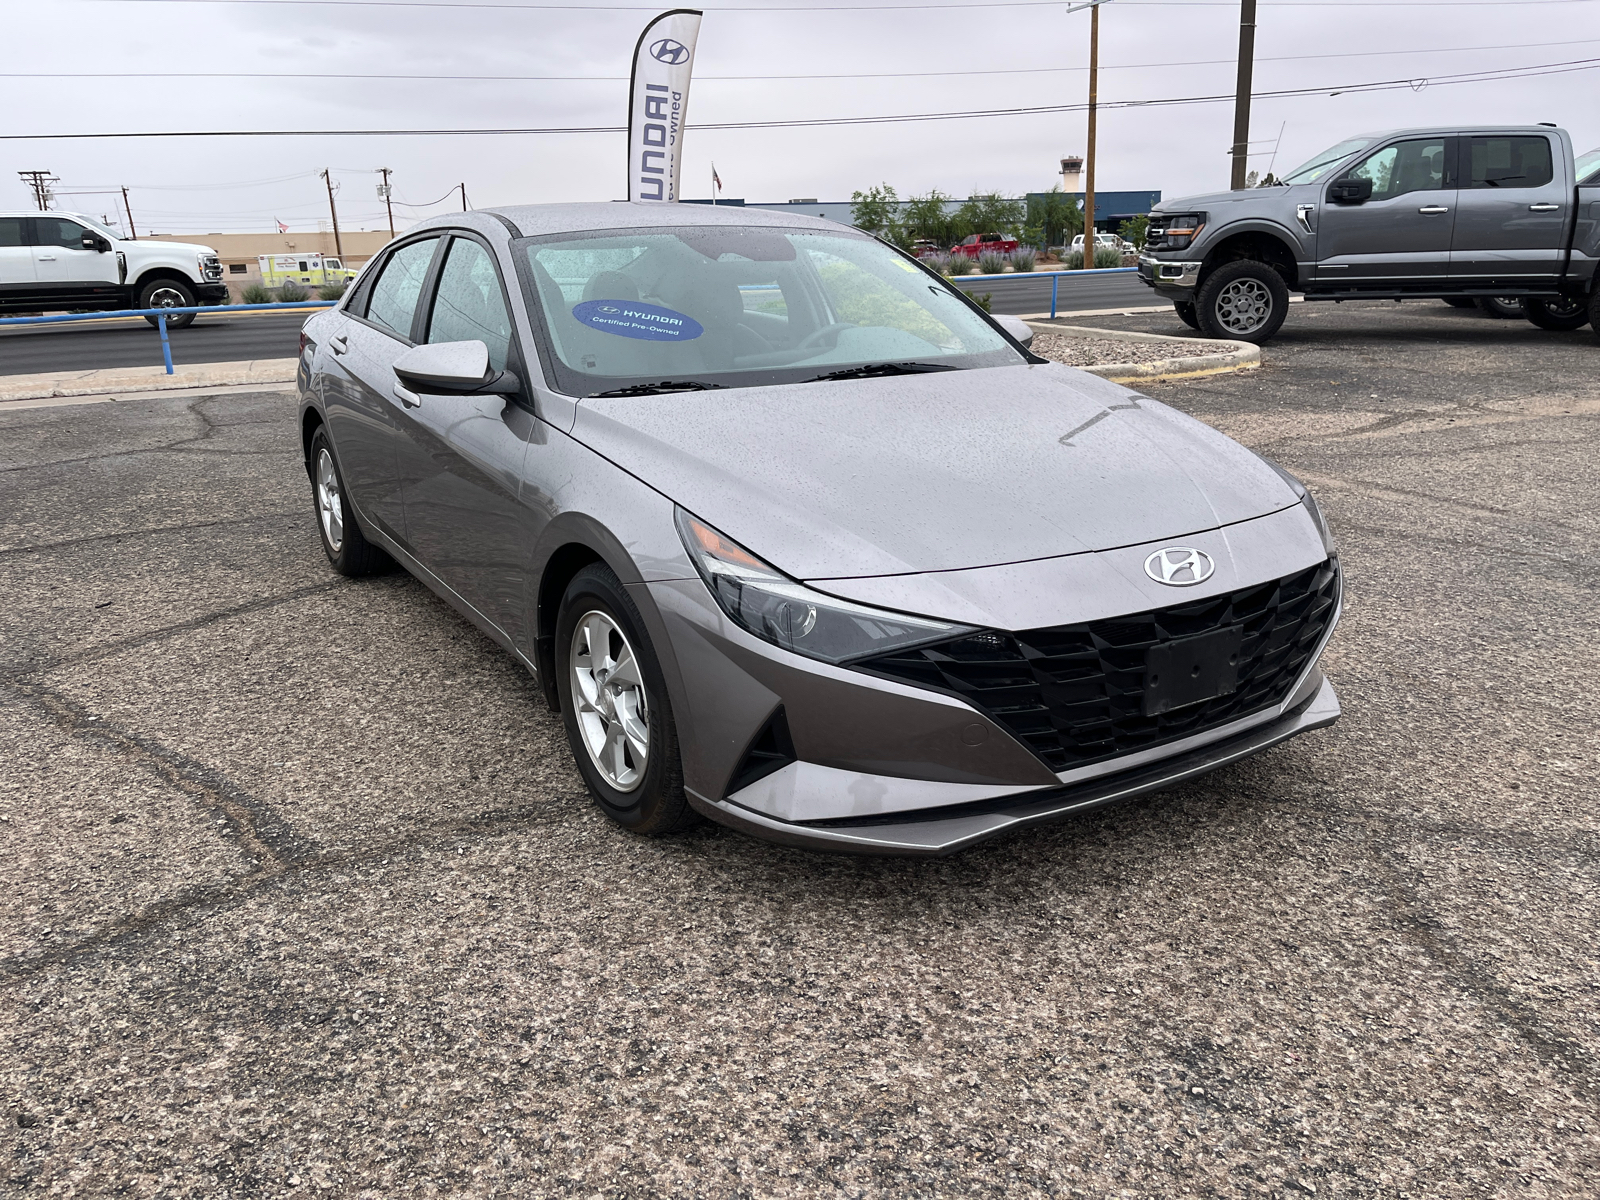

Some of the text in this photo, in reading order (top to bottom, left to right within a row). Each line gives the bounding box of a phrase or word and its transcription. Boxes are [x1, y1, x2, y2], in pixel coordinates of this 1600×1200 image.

[592, 316, 680, 336] Certified Pre-Owned
[623, 310, 683, 326] HYUNDAI
